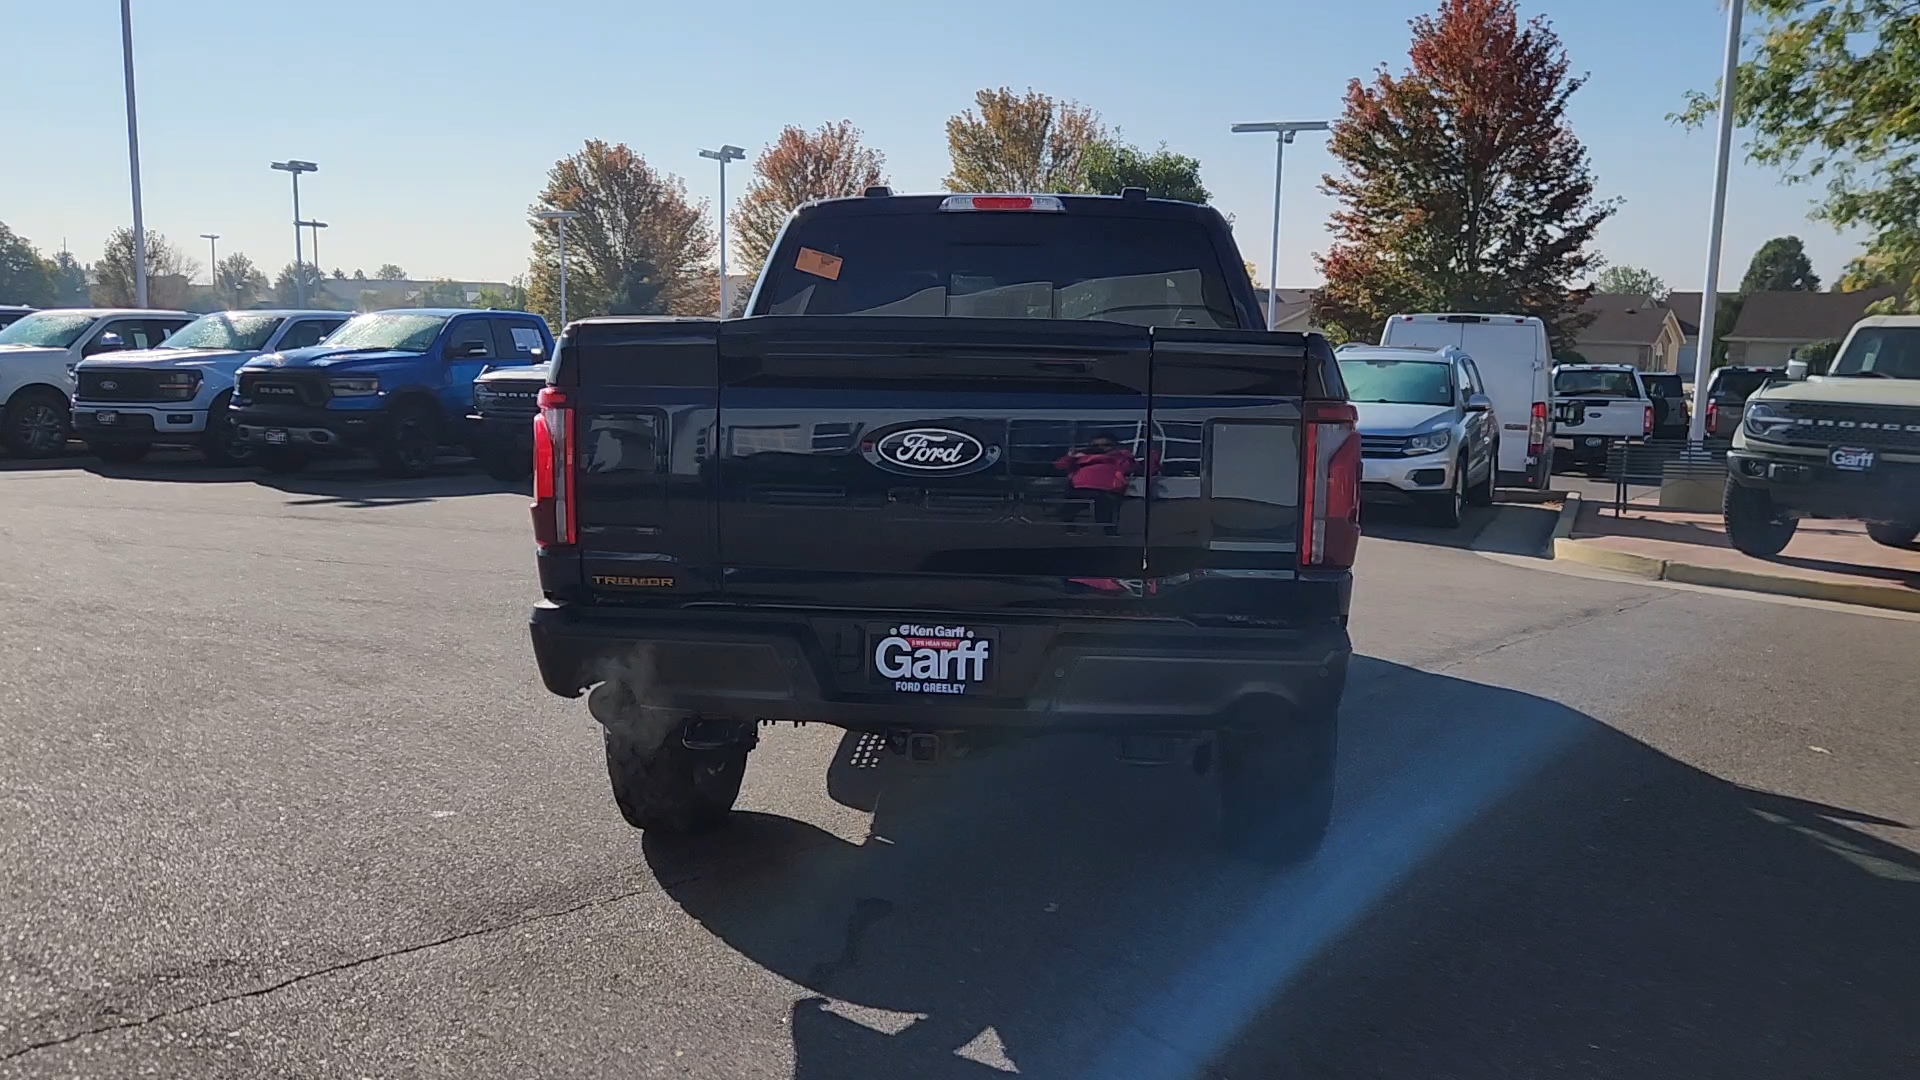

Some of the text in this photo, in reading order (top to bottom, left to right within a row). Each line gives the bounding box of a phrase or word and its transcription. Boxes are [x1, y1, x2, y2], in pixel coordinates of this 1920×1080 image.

[1797, 419, 1920, 432] BRONCO
[896, 433, 964, 463] Ford
[1832, 450, 1874, 467] Garff
[592, 575, 674, 587] TREMOR
[910, 625, 965, 638] Ken Garff
[875, 637, 989, 681] Garff
[895, 681, 965, 694] FORD GREELEY
